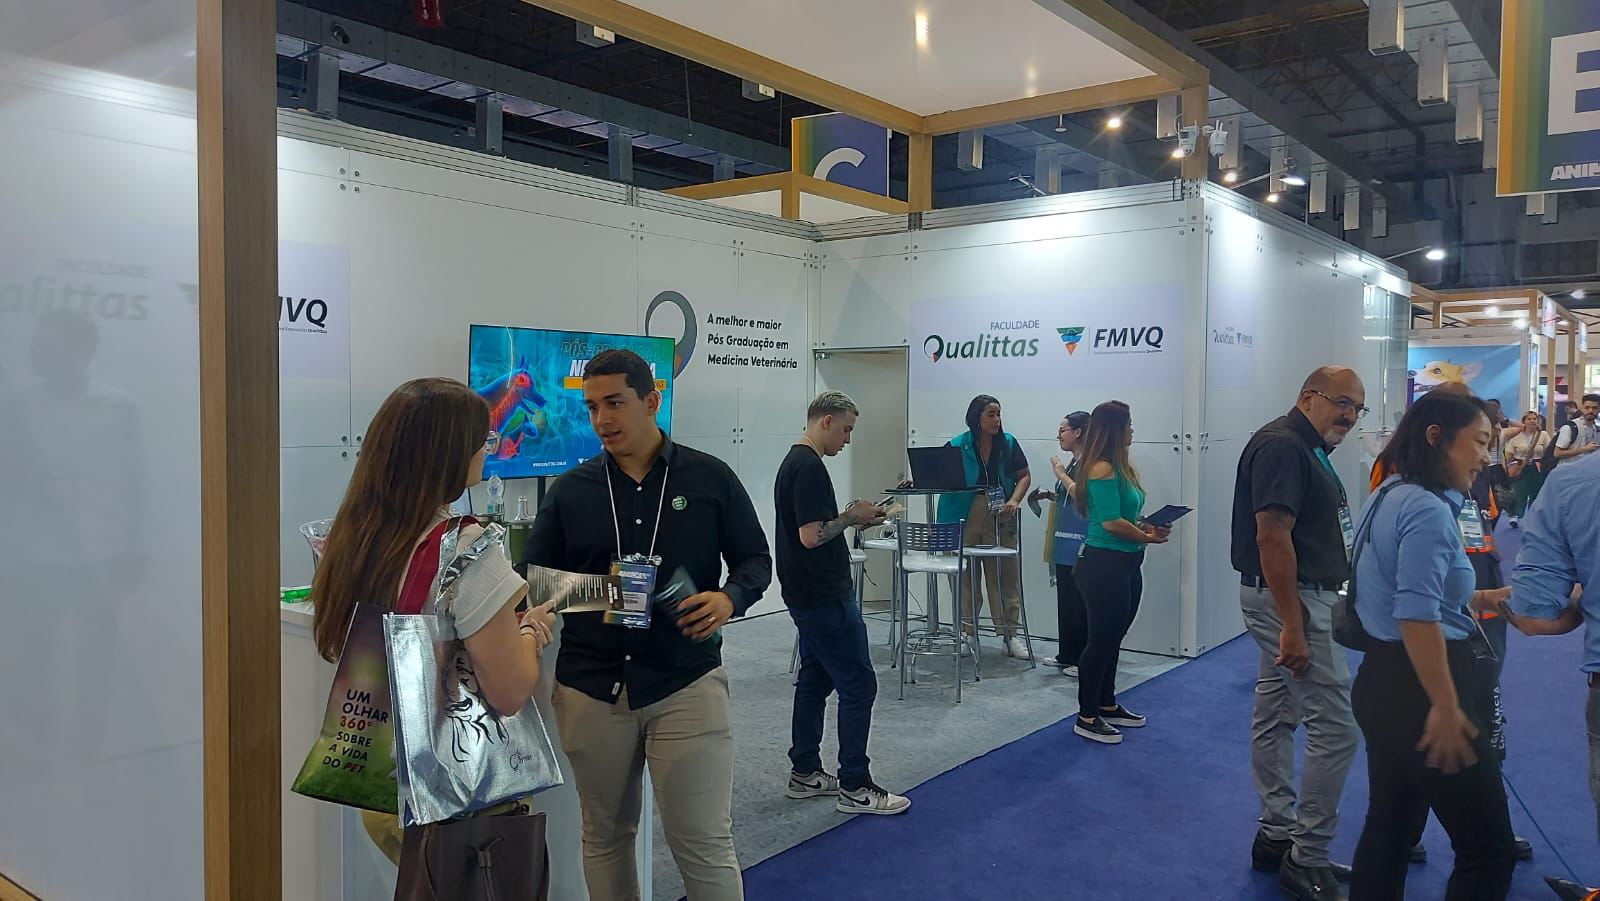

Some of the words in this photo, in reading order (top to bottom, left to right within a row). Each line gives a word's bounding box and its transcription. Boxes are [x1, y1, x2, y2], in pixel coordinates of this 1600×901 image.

[278, 296, 328, 328] VQ
[707, 313, 714, 324] A
[716, 315, 748, 327] melhor
[749, 320, 755, 328] e
[757, 319, 782, 330] maior
[990, 320, 1040, 331] FACULDADE
[707, 333, 724, 345] Pós
[726, 335, 775, 351] Graduação
[776, 341, 789, 350] em
[1093, 326, 1164, 348] FMVQ
[923, 333, 1039, 363] Qualittas
[707, 353, 749, 366] Medicina
[751, 356, 798, 369] Veterinária
[346, 689, 371, 704] UM
[342, 702, 389, 723] OLHAR
[336, 731, 372, 747] SOBRE
[329, 744, 337, 752] A
[342, 746, 368, 760] VIDA
[322, 755, 341, 768] DO
[342, 762, 366, 773] PET
